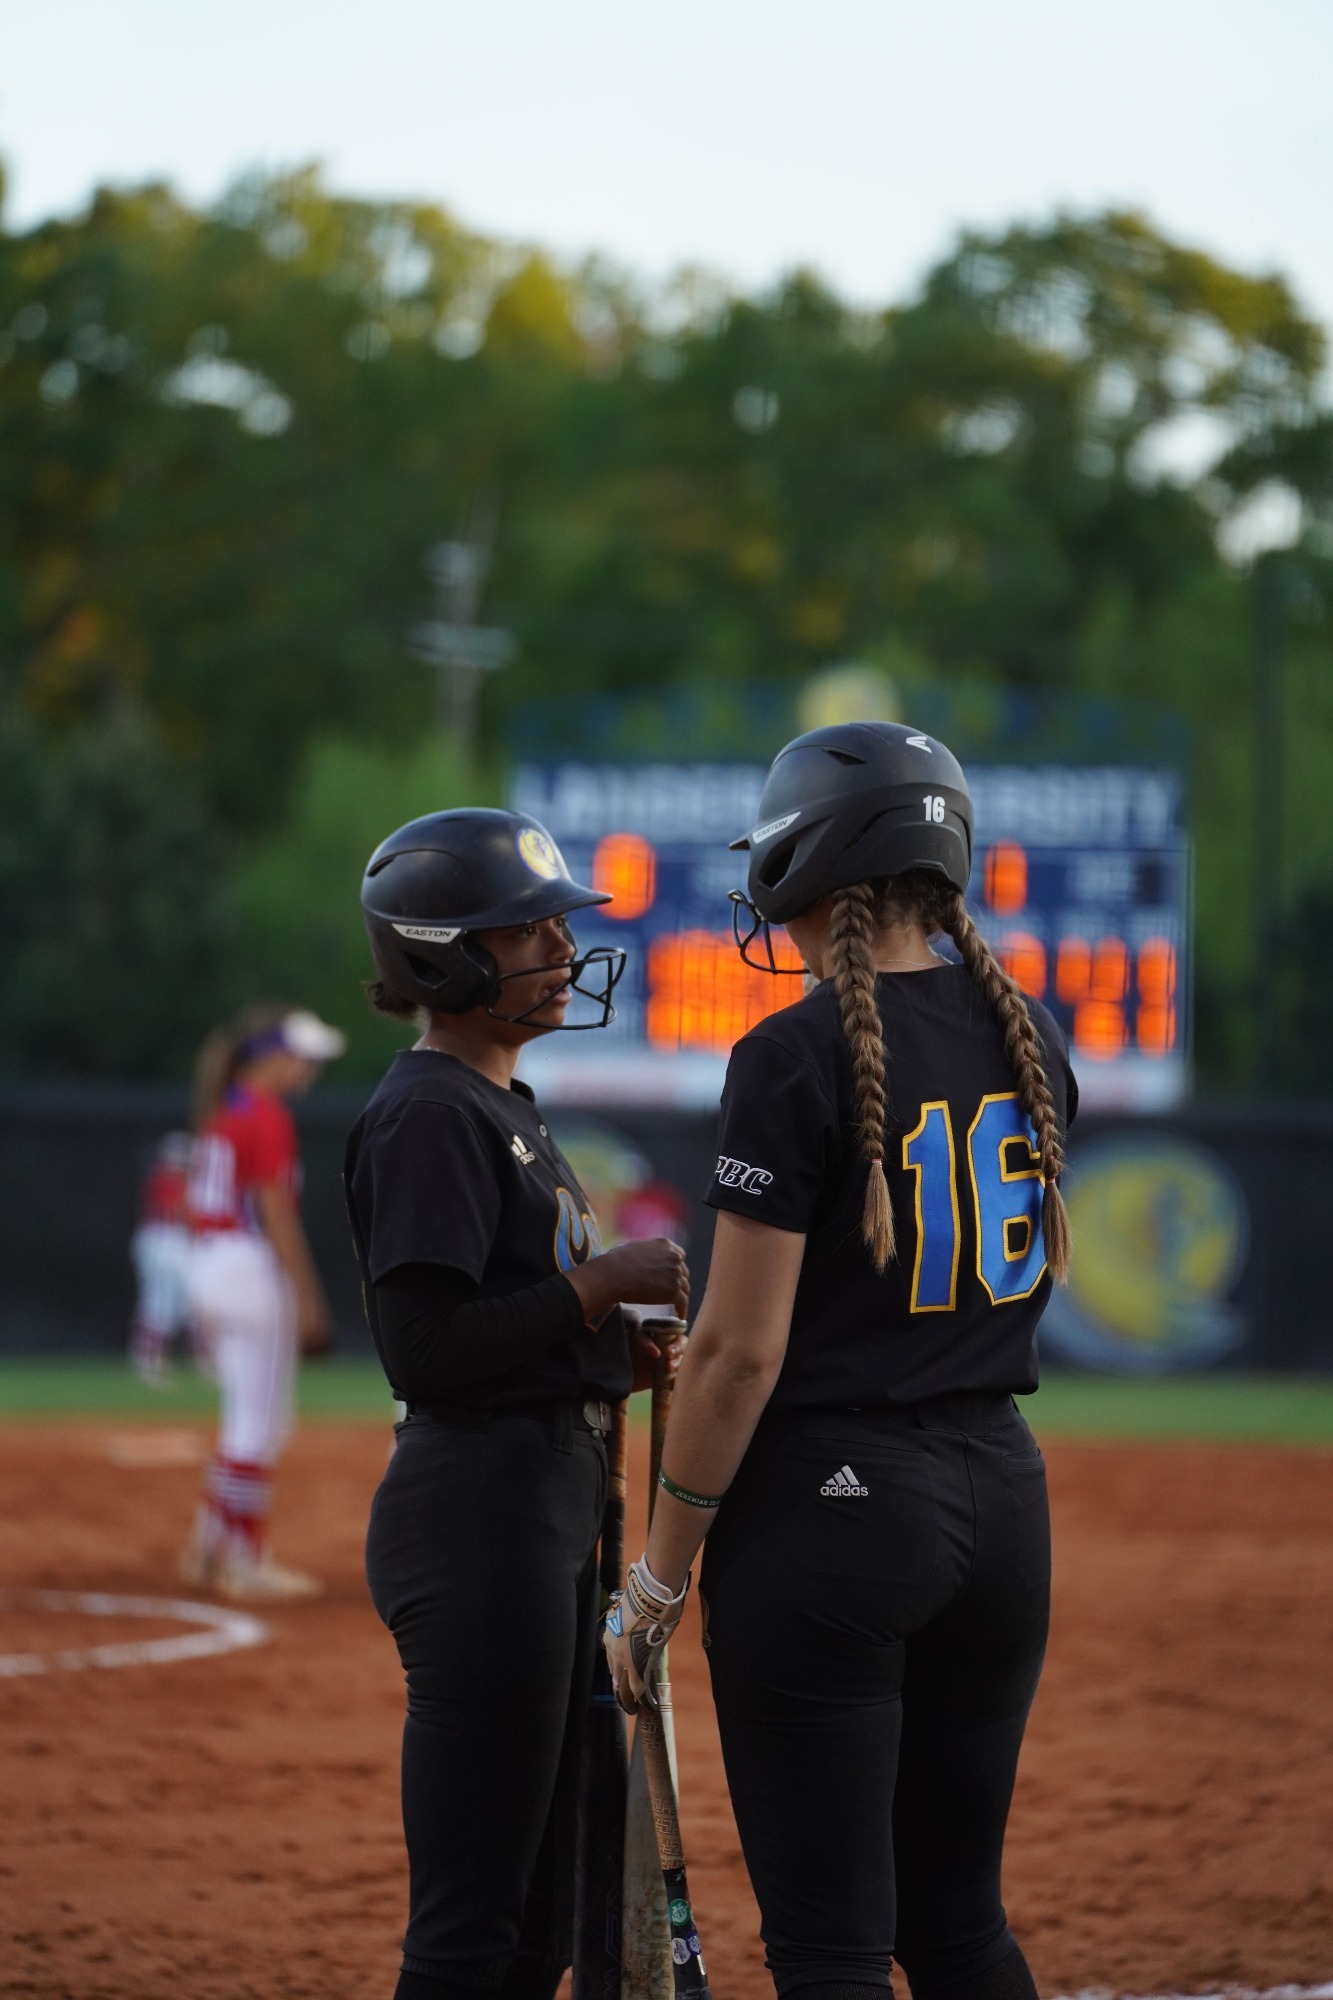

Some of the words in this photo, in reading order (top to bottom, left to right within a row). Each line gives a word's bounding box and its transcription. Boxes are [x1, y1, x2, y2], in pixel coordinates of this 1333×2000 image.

[922, 795, 946, 824] 16
[757, 819, 788, 838] EASTON
[405, 927, 452, 938] EASTON
[902, 1091, 1047, 1314] 16
[675, 1490, 709, 1506] JEREMIAH
[820, 1484, 869, 1497] adidas
